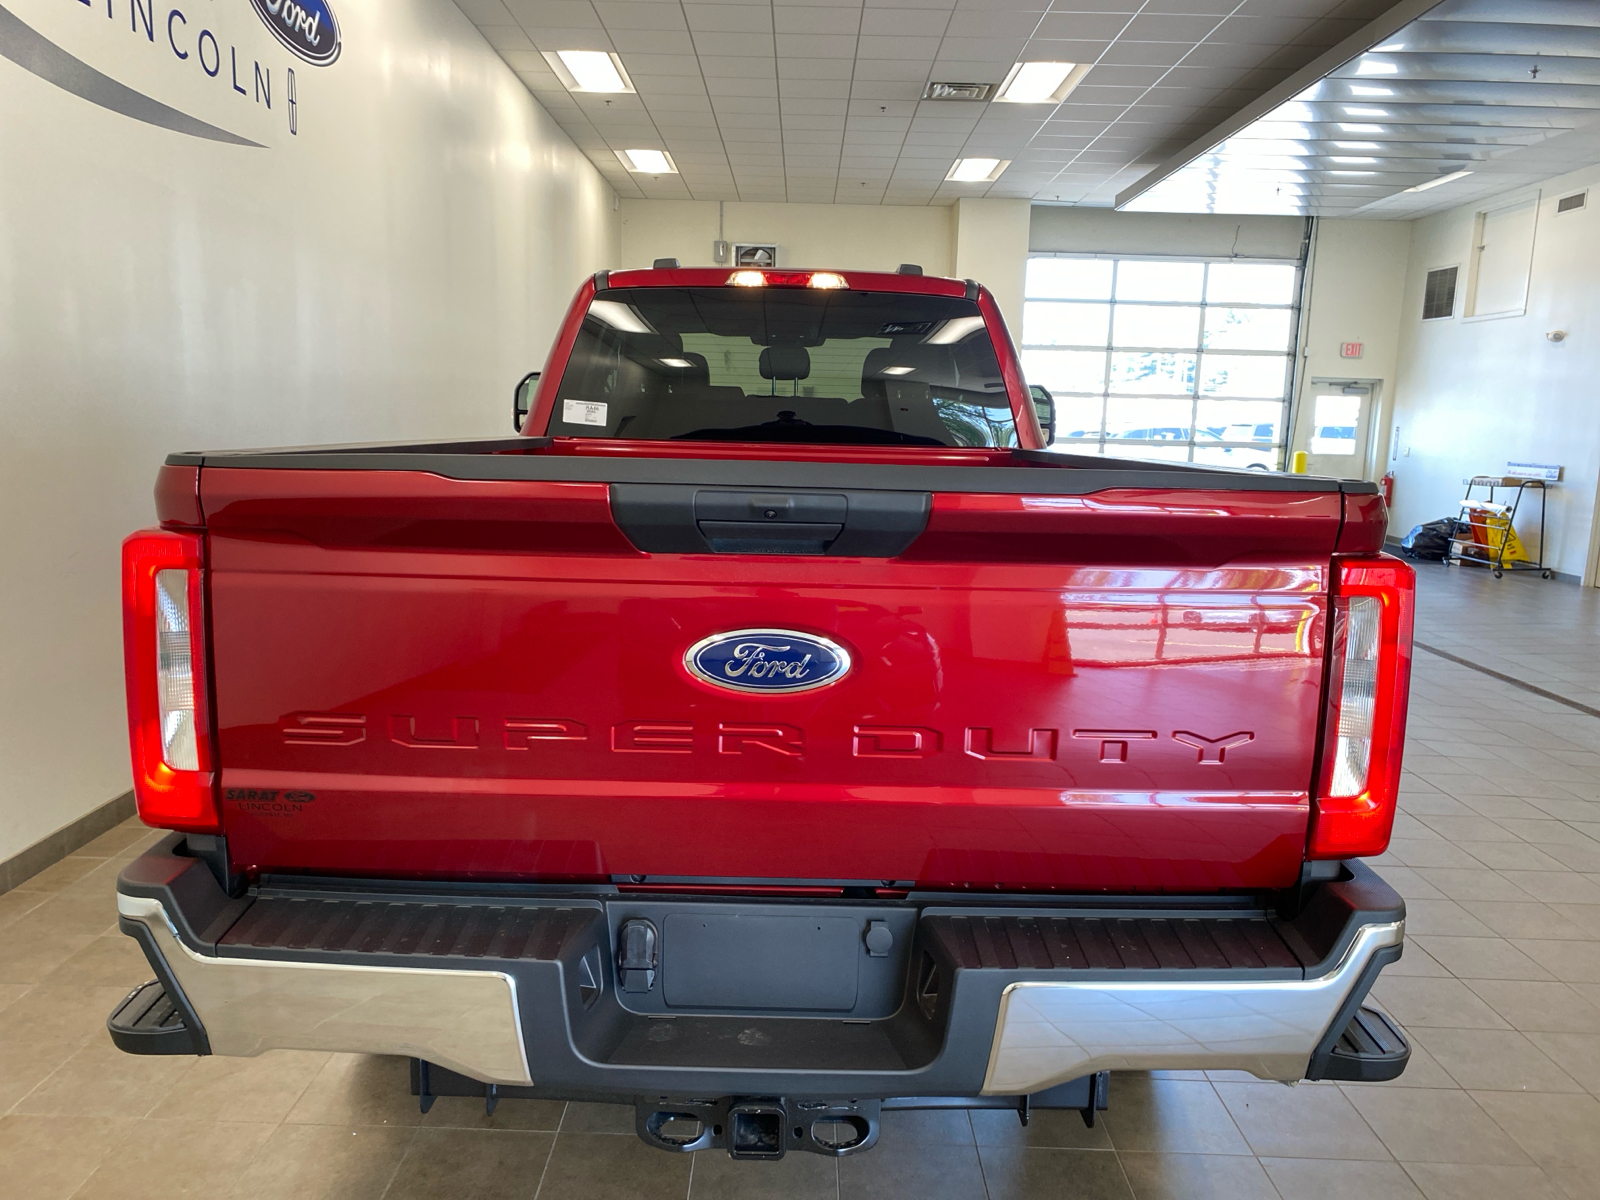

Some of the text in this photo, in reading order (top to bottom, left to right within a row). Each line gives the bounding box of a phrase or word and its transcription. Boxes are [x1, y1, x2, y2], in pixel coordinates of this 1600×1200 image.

[76, 0, 272, 110] NCOLN
[1345, 343, 1362, 356] EXIT
[724, 643, 812, 679] Ford
[279, 710, 1256, 764] SUPER DUTY
[226, 789, 279, 800] SARAT
[238, 802, 303, 812] LINCOLN
